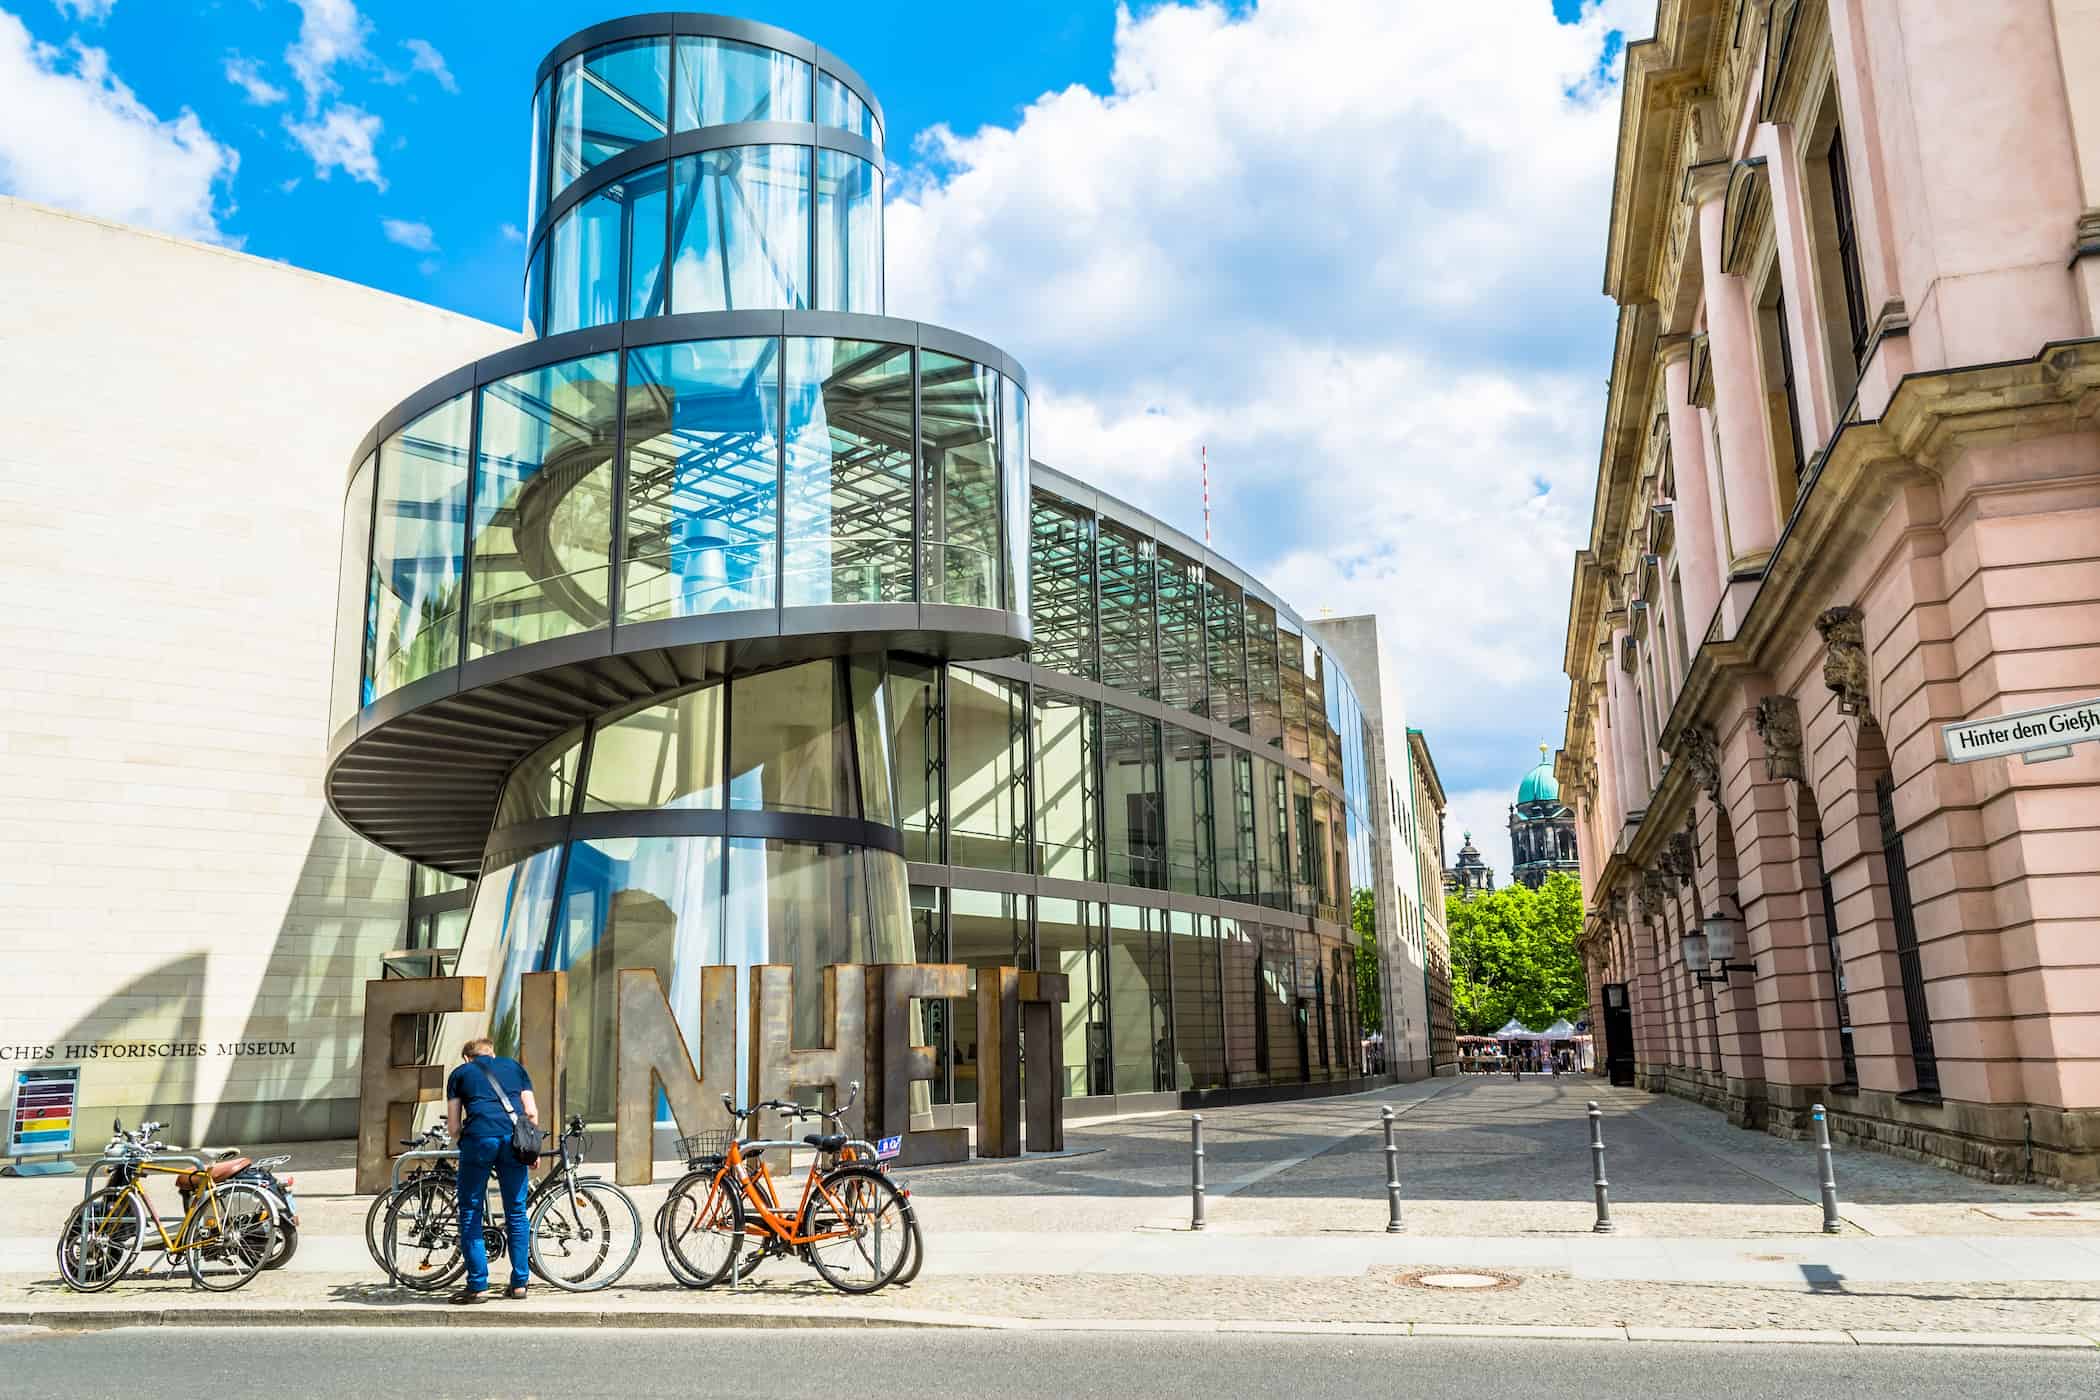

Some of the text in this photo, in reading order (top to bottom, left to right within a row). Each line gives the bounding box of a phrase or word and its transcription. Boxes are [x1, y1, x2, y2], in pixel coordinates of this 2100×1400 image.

[1959, 729, 2010, 749] Hinter
[2012, 721, 2048, 740] dem
[0, 1041, 297, 1060] CHES HISTORISCHES MUSEUM
